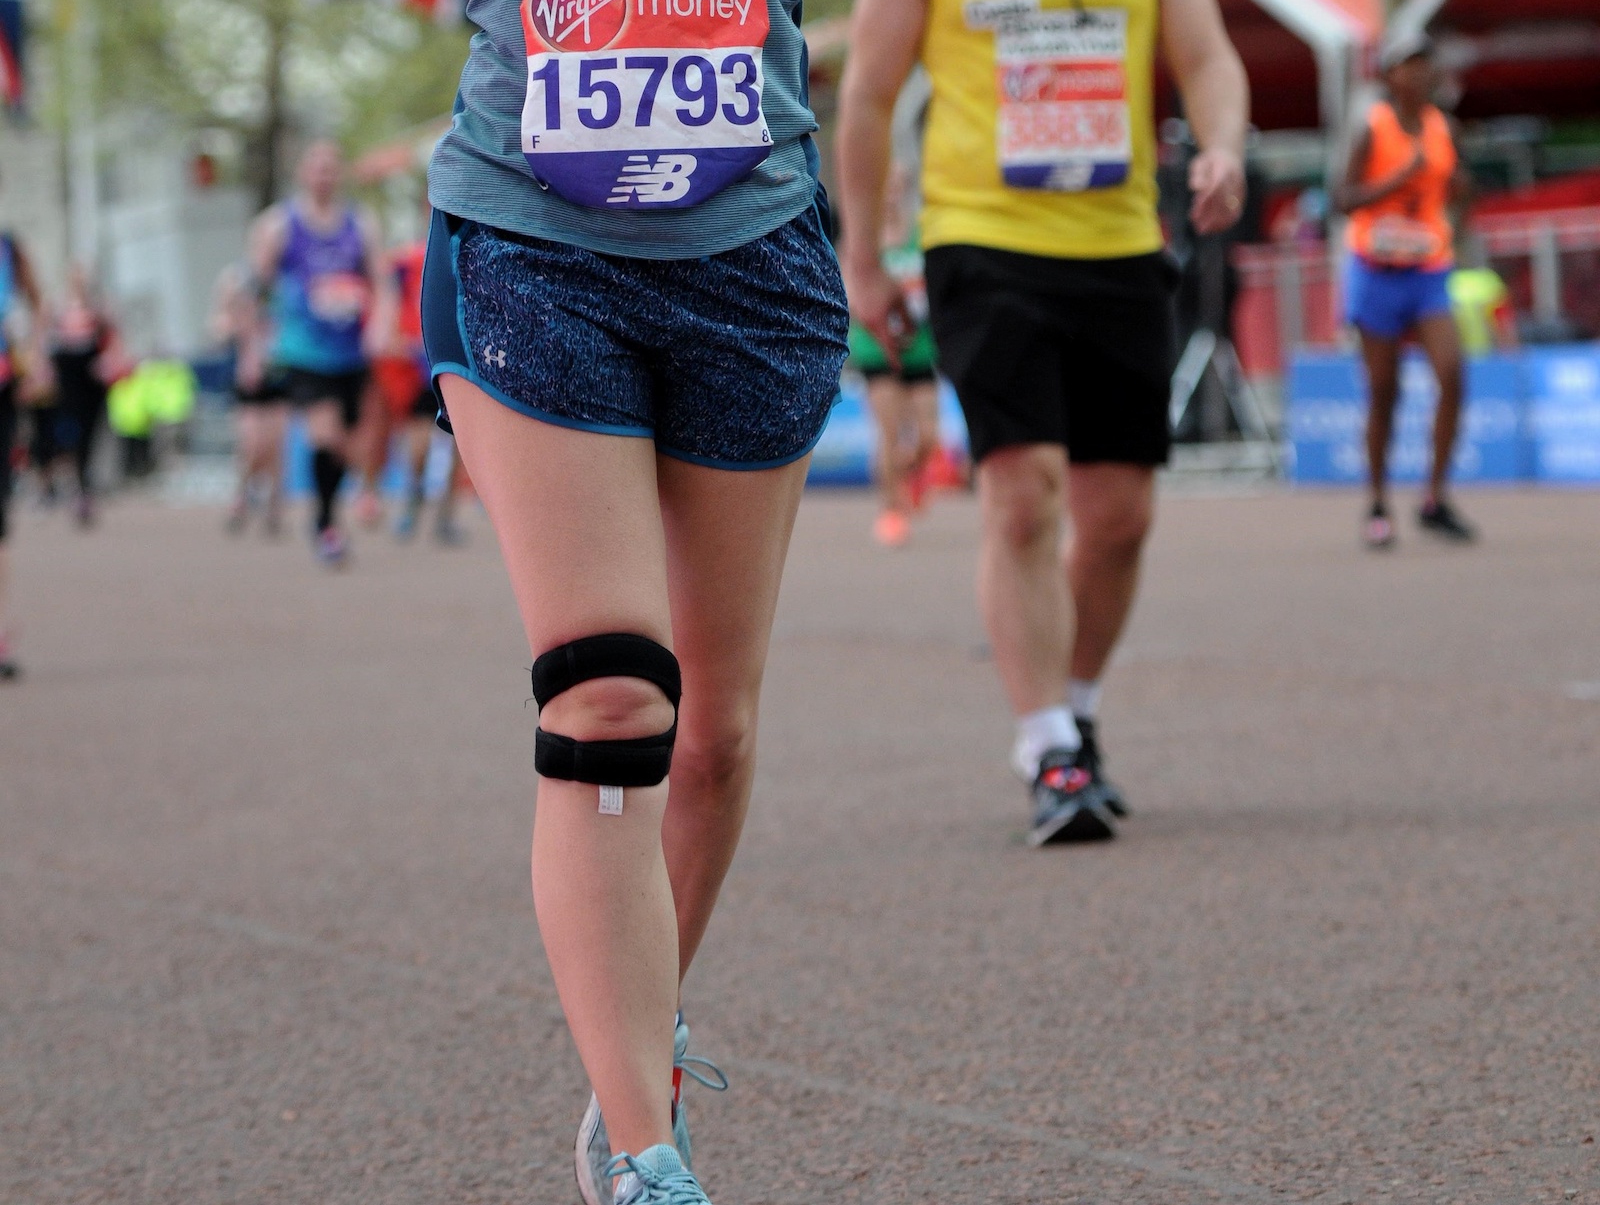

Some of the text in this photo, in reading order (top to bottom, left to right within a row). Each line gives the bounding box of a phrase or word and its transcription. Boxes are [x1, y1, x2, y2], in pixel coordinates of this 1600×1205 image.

[532, 53, 760, 130] 15793
[532, 135, 540, 149] F
[606, 153, 698, 203] NB
